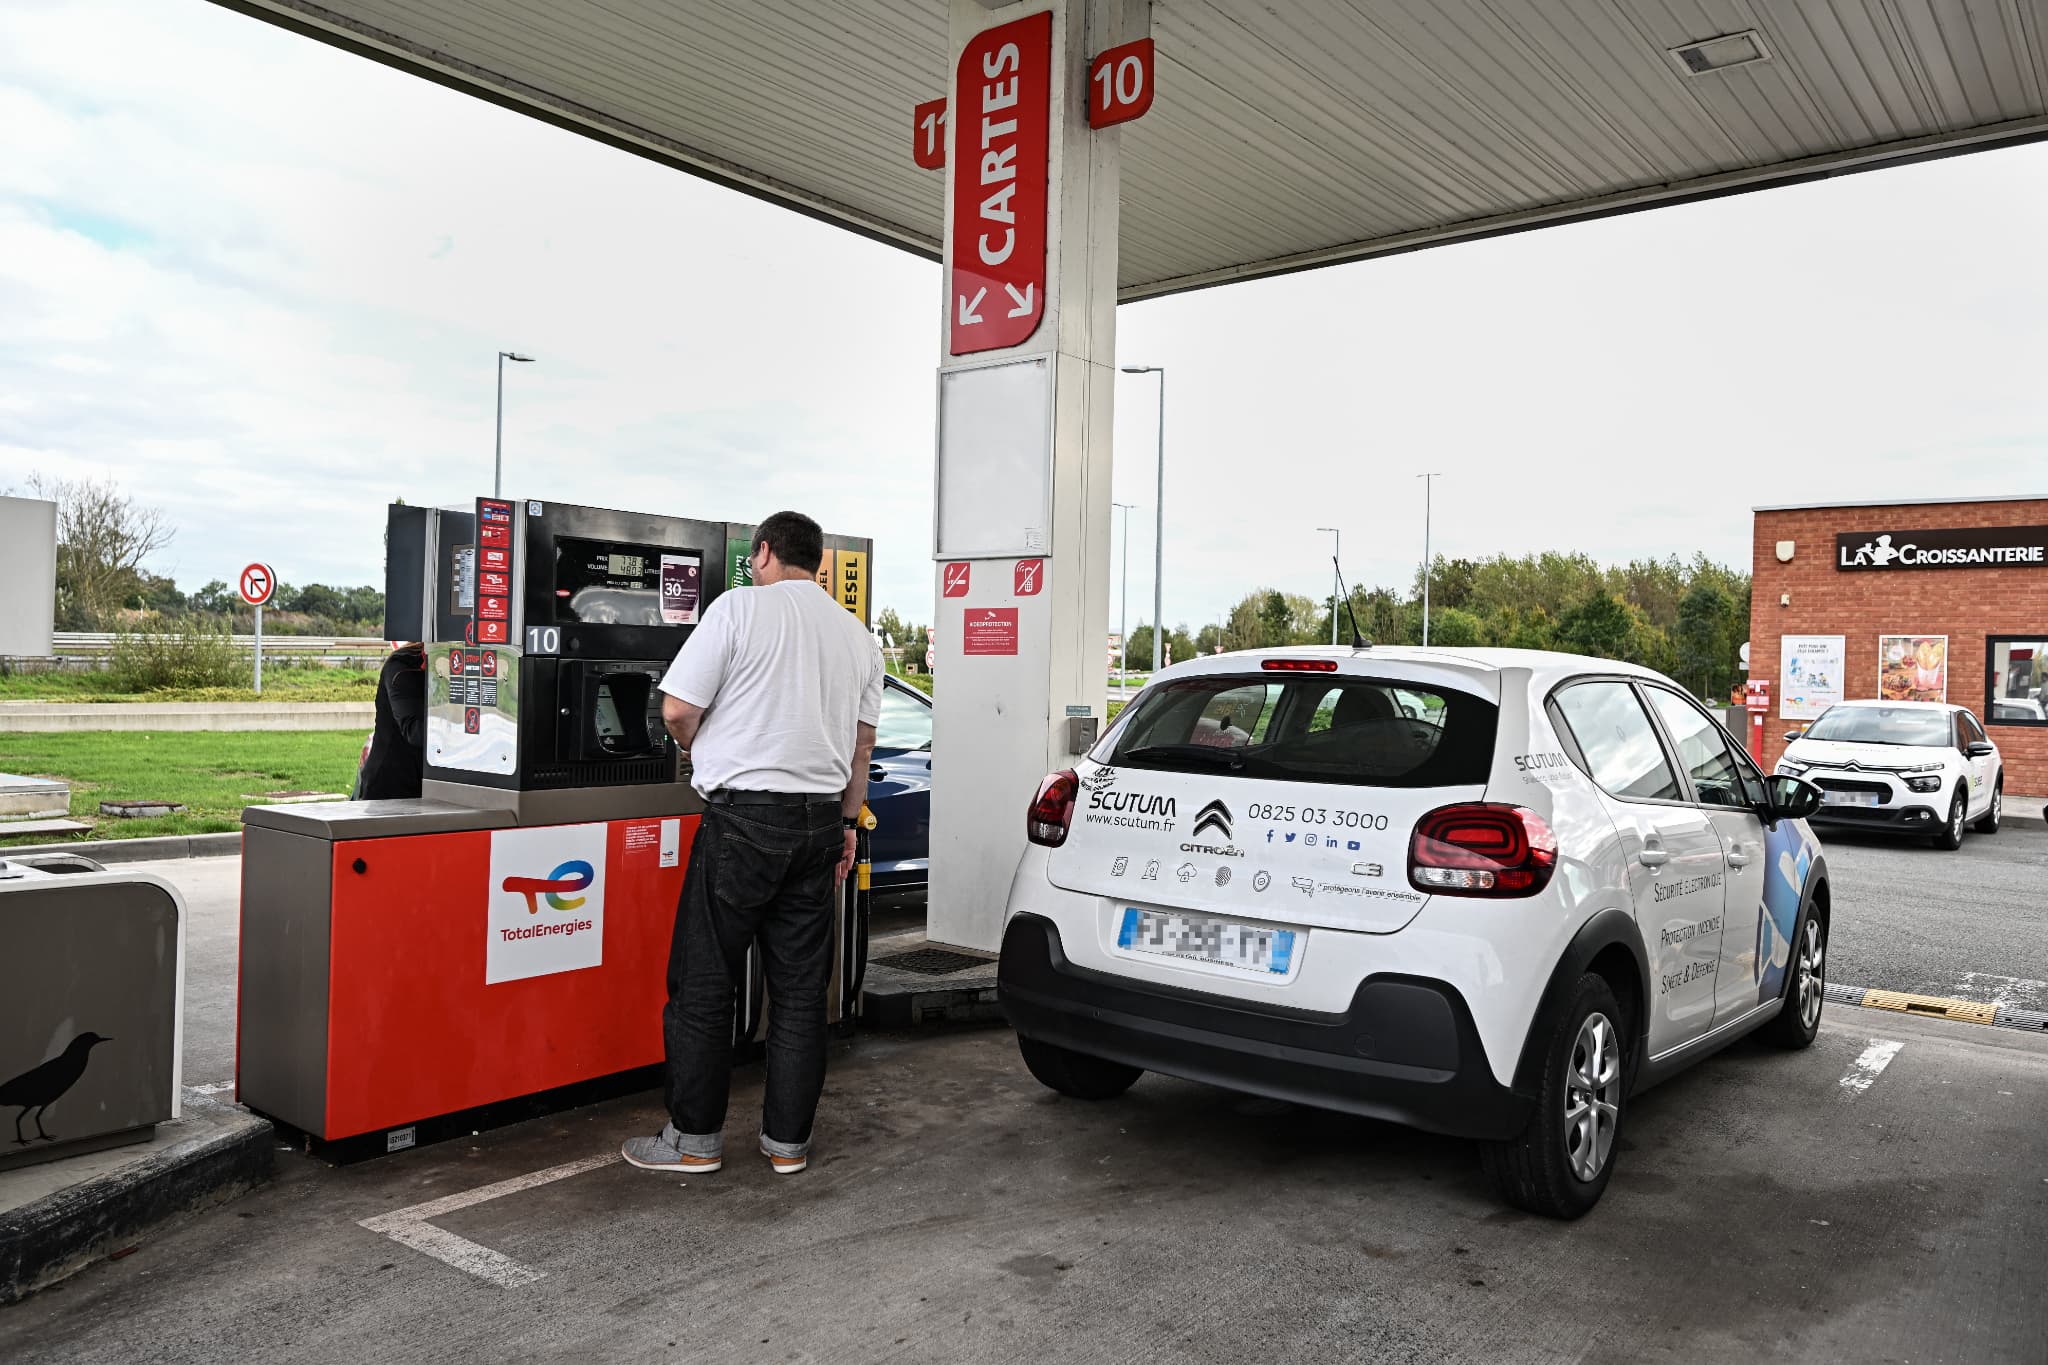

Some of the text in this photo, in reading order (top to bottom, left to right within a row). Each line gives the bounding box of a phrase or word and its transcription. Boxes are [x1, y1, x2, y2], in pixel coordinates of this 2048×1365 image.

[1094, 55, 1144, 111] 10
[979, 42, 1020, 266] CARTES
[1898, 543, 2045, 565] CROISSANTERIE
[664, 583, 682, 596] 30
[819, 569, 828, 591] SEL
[845, 558, 858, 614] IESEL
[529, 628, 558, 653] 10
[465, 654, 480, 663] STOP
[1514, 752, 1568, 772] SCUTUM
[1089, 791, 1176, 818] SCUTUM
[1086, 814, 1176, 833] www.scutum.fr
[1248, 803, 1389, 831] 0825 03 3000
[500, 918, 592, 942] TotalEnergies
